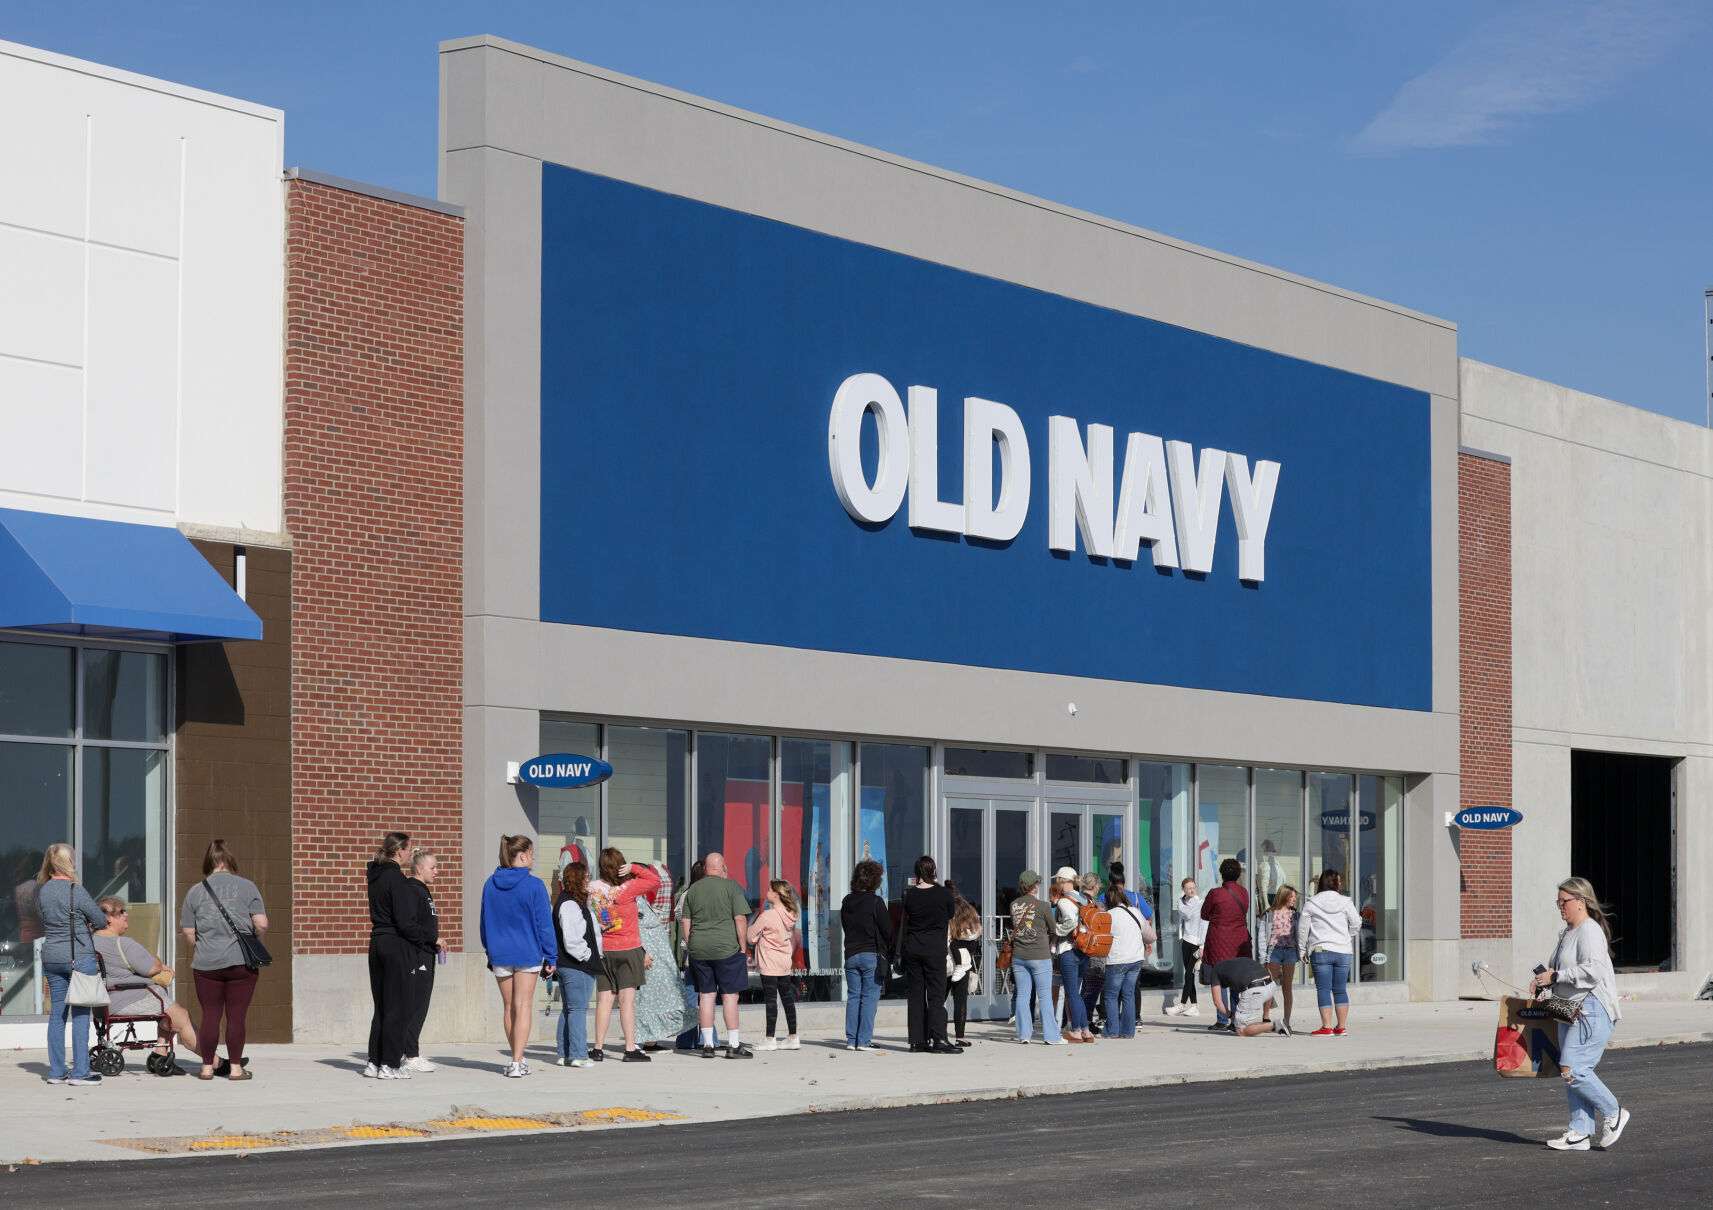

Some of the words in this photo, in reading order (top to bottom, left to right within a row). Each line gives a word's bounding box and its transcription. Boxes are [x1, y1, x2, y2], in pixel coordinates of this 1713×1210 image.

[828, 372, 1031, 541] OLD
[1048, 414, 1281, 582] NAVY
[529, 764, 554, 778] OLD
[556, 763, 592, 777] NAVY
[1462, 813, 1481, 823] OLD
[1482, 812, 1510, 823] NAVY
